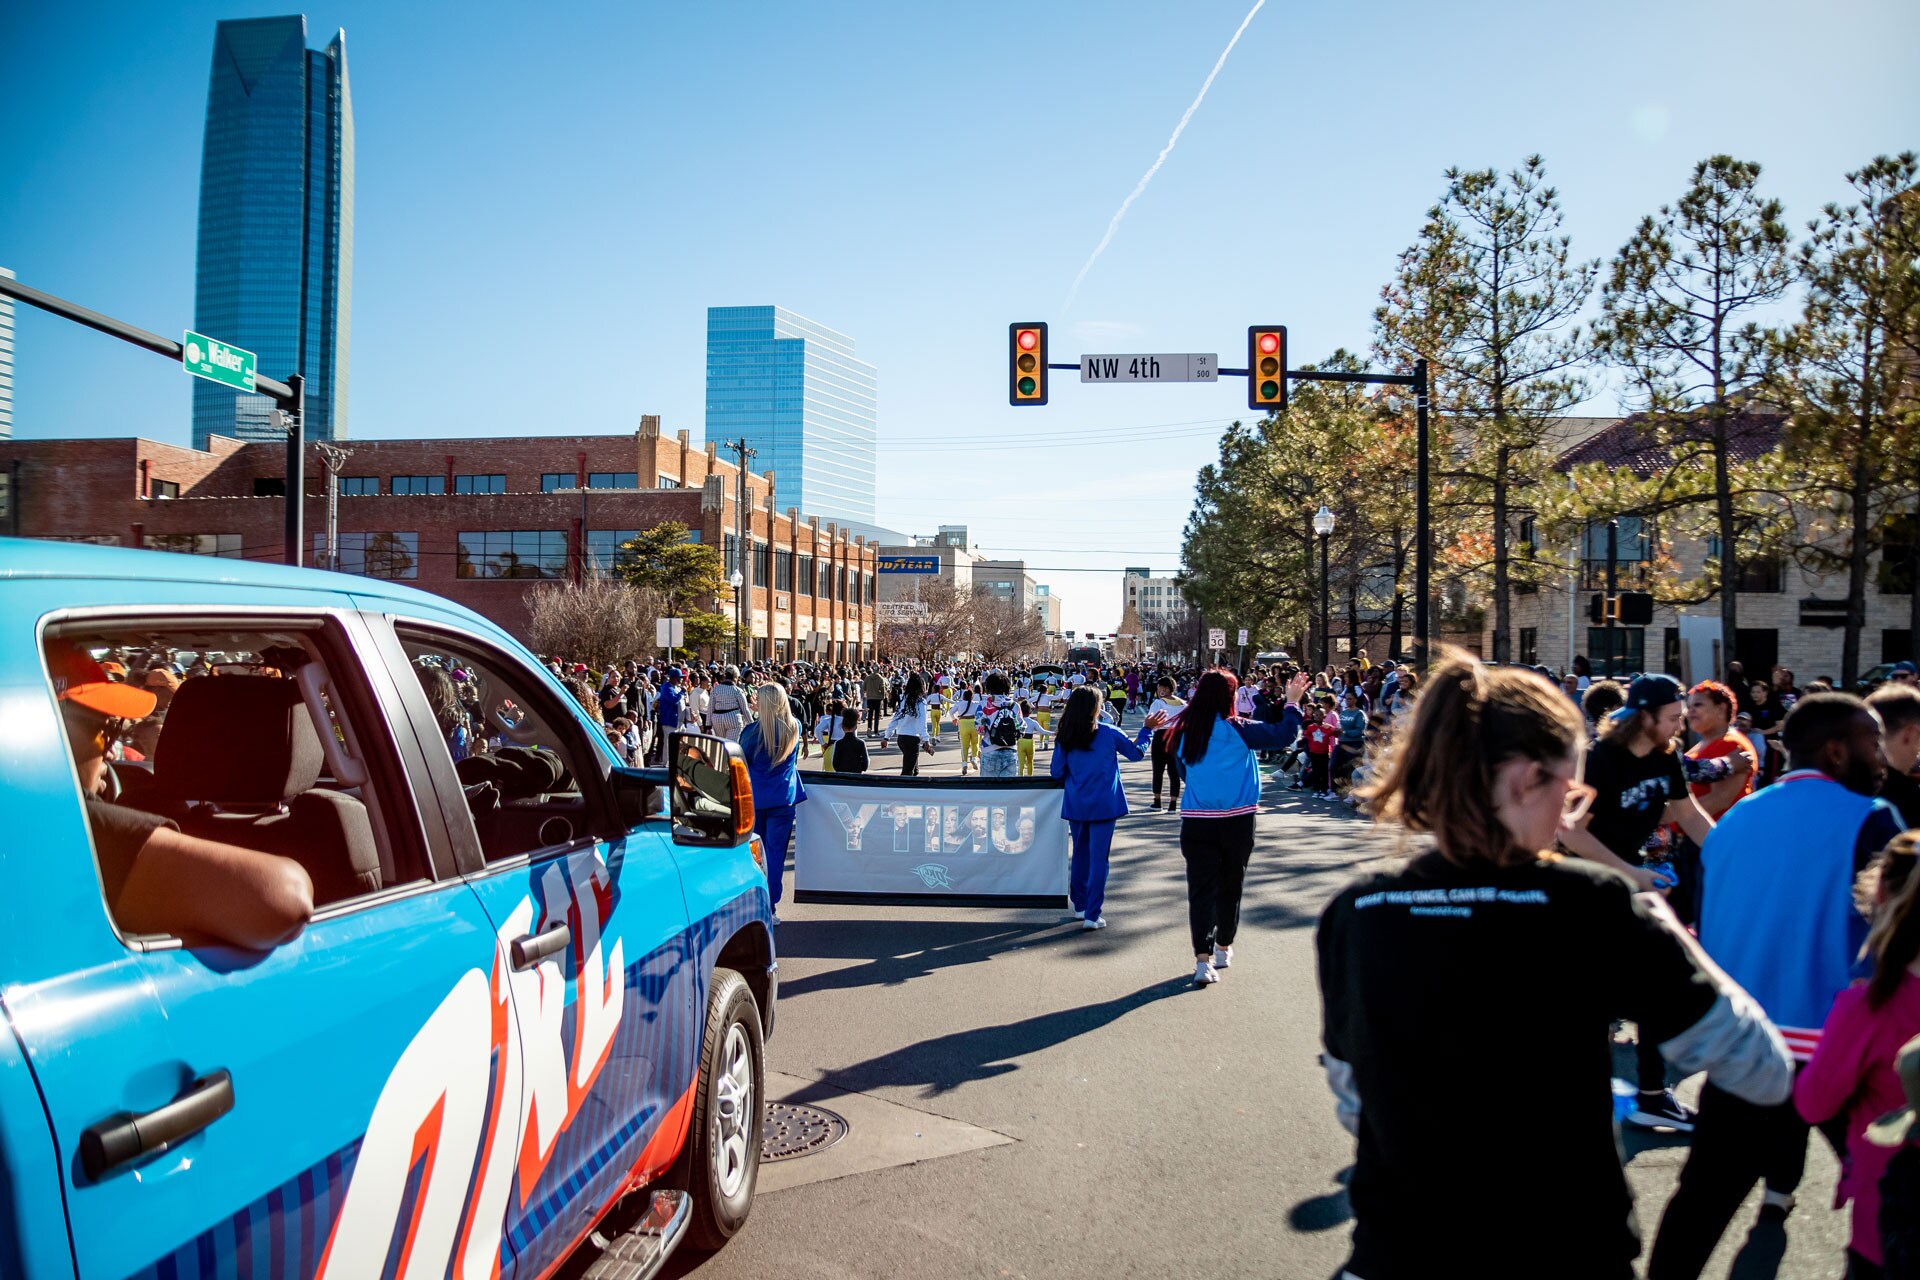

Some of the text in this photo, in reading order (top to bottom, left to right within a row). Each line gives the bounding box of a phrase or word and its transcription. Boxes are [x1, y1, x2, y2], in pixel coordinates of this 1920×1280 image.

[208, 341, 244, 373] Walker
[1199, 357, 1207, 366] St
[1088, 356, 1161, 379] NW 4th
[1211, 638, 1224, 646] 30
[1449, 888, 1477, 903] CAN
